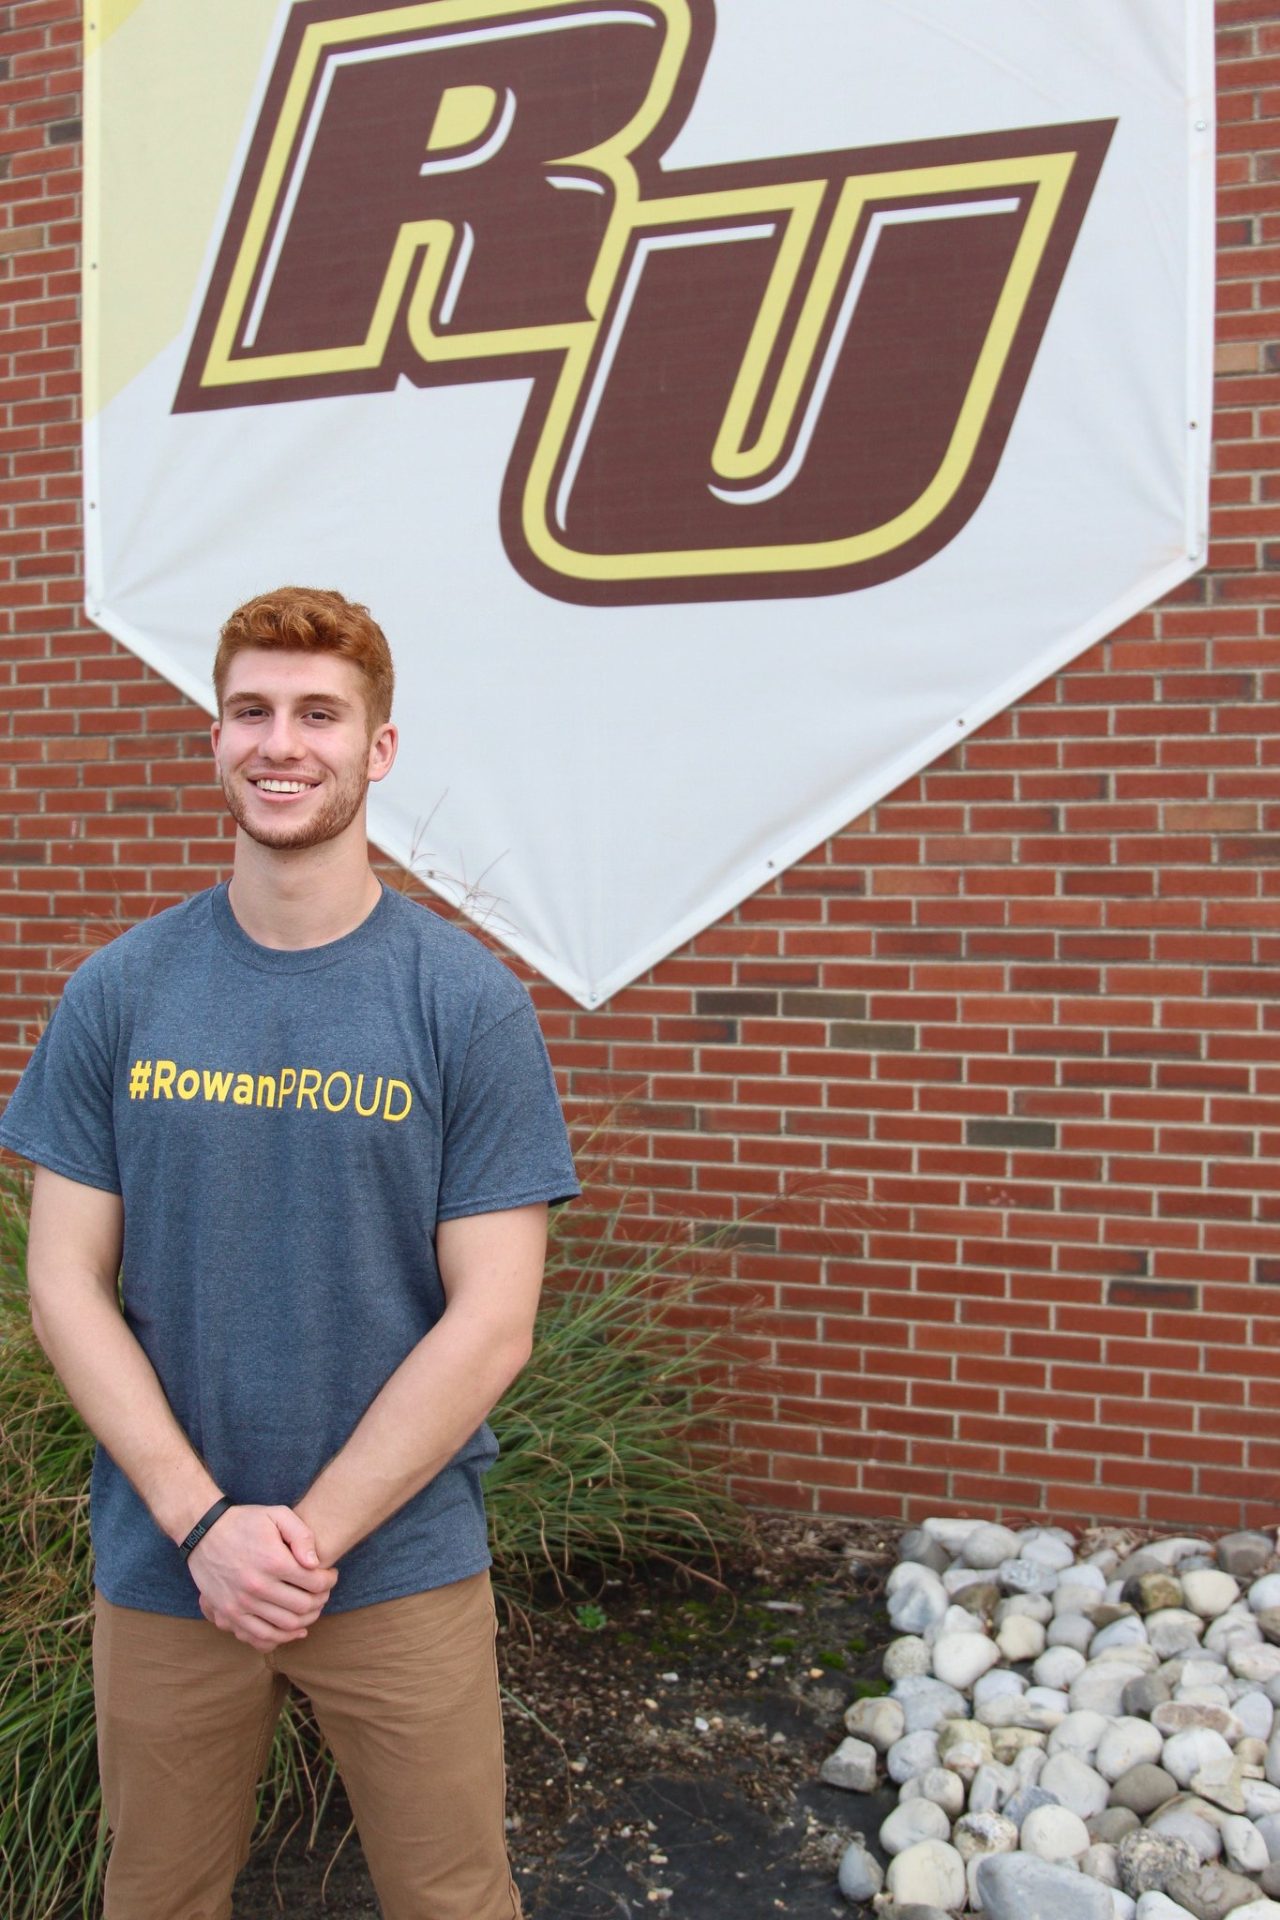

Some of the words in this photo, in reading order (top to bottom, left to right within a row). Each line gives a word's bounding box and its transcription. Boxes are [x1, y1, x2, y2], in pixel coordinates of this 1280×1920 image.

[170, 0, 1118, 607] RU
[129, 1060, 412, 1121] #RowanPROUD
[185, 1524, 206, 1548] PUSH
